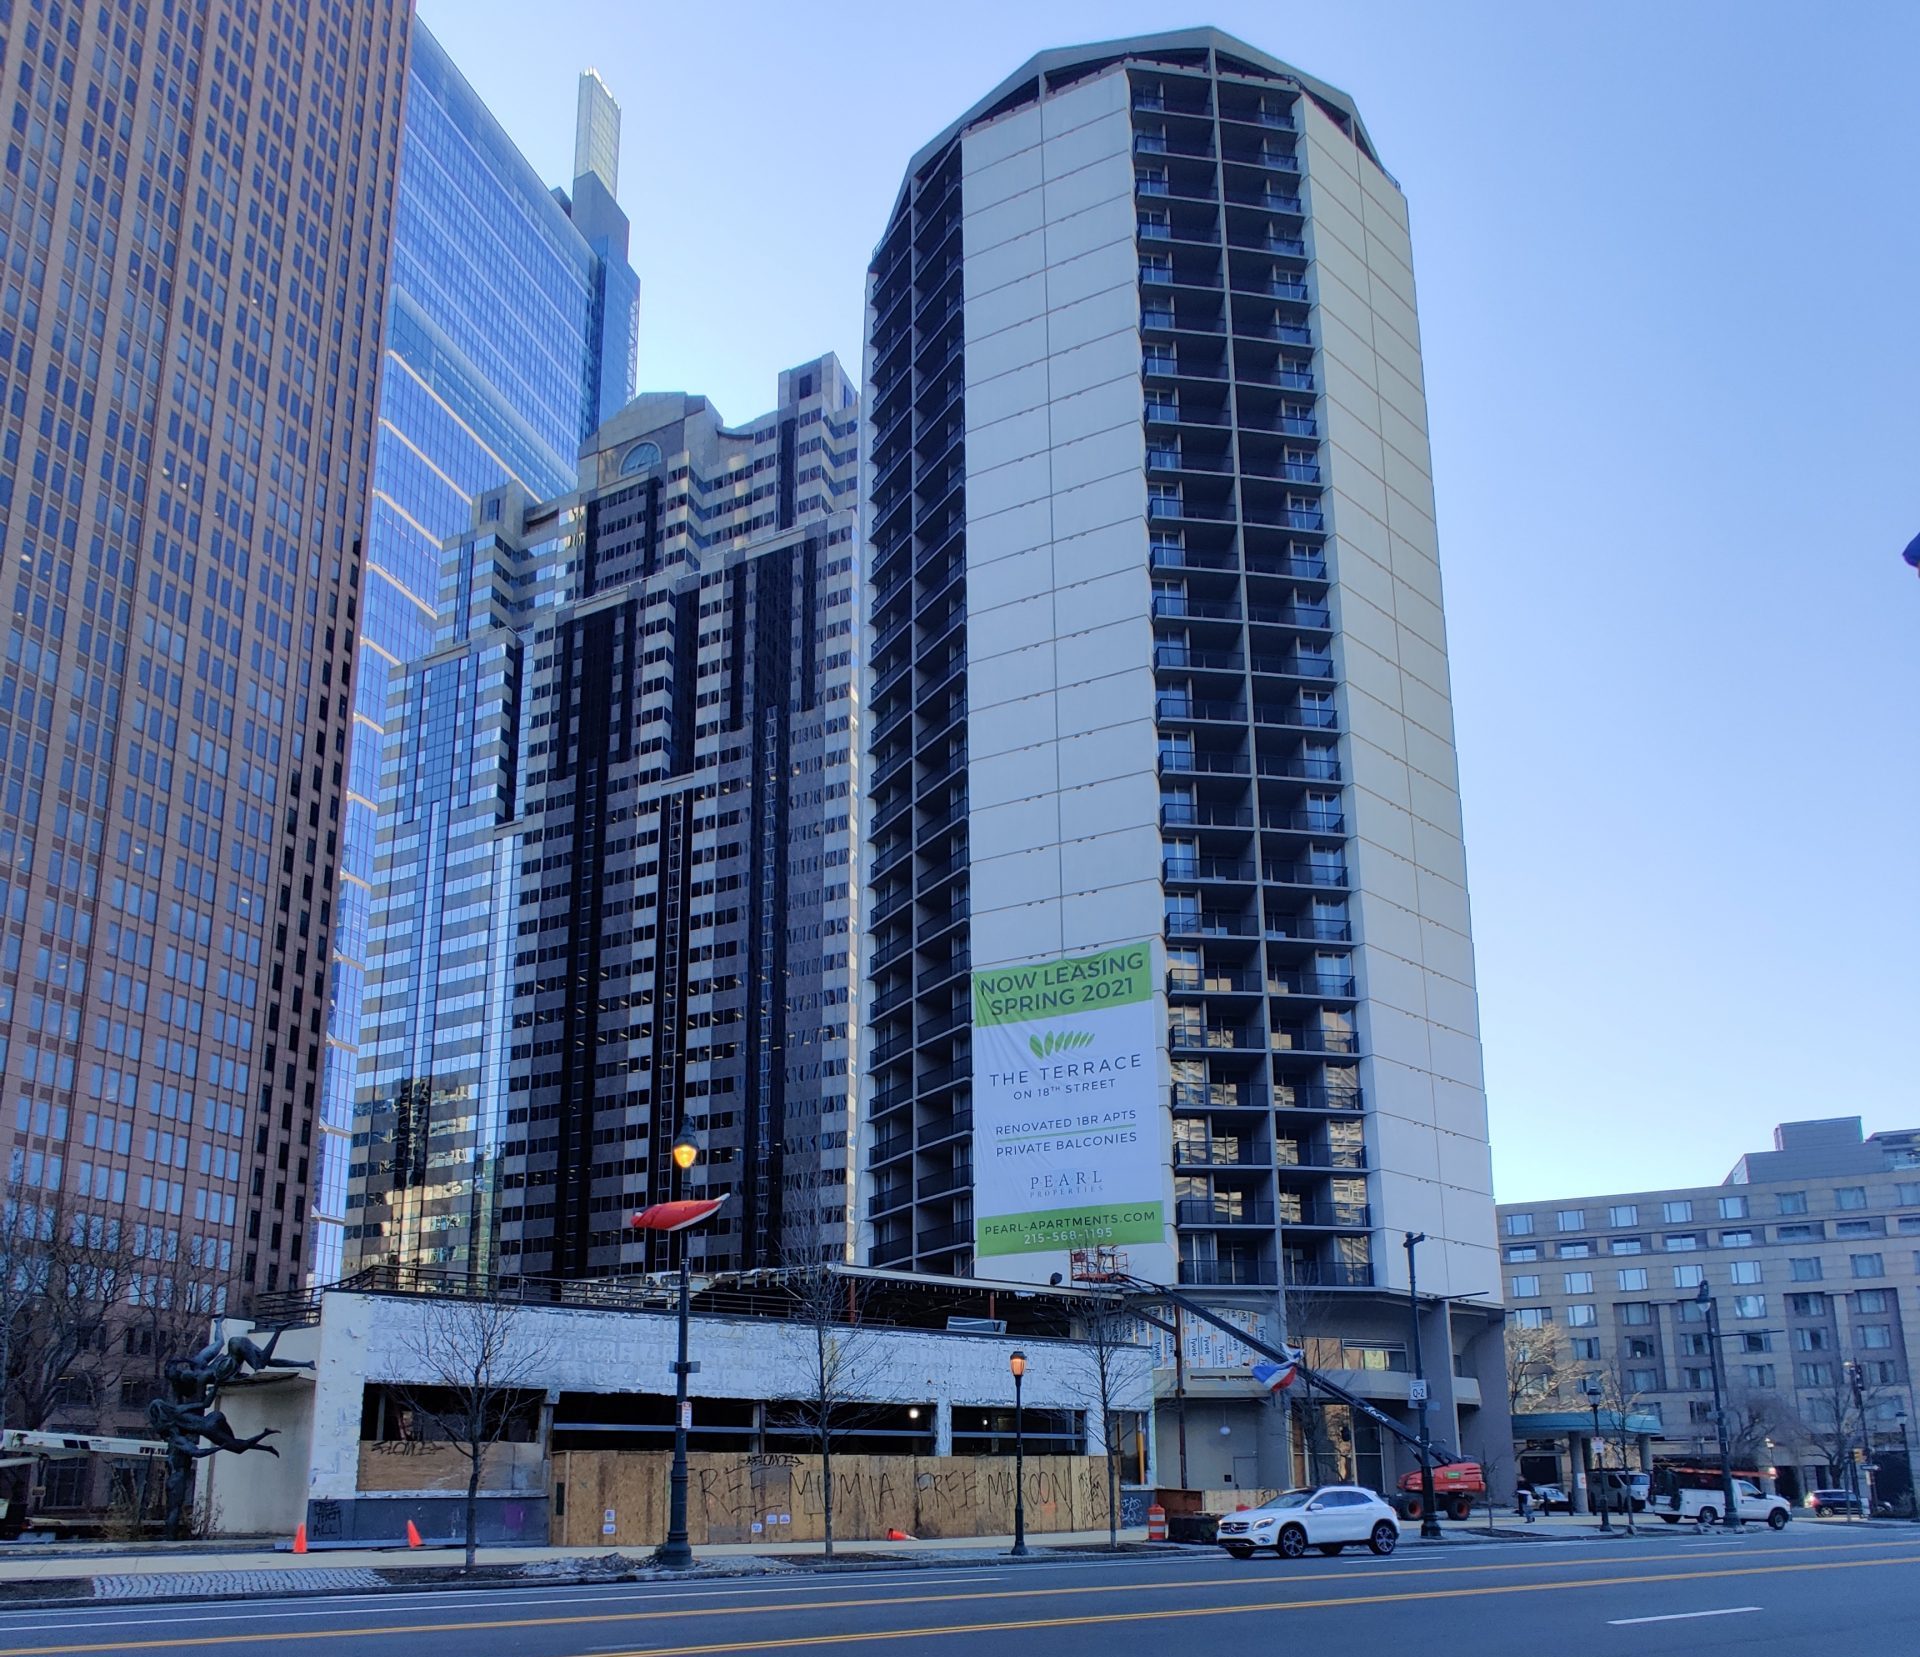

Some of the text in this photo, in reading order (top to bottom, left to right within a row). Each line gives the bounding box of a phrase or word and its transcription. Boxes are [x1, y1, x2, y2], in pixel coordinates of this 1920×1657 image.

[980, 952, 1143, 996] NOW LEASING
[991, 977, 1133, 1016] SPRING 2021
[990, 1053, 1141, 1087] THE TERRACE
[1013, 1078, 1116, 1100] ON 18TH STREET
[995, 1109, 1136, 1136] RENOVATED 1BR APTS
[996, 1132, 1137, 1158] PRIVATE BALCONIES
[1030, 1170, 1103, 1190] PEARL
[1030, 1185, 1104, 1199] PROPERTIES
[985, 1211, 1155, 1236] PEARL-APARTMENTS.COM
[1024, 1227, 1113, 1245] 215-568-1195
[788, 1470, 896, 1520] MUMIA
[917, 1470, 985, 1519] FREE
